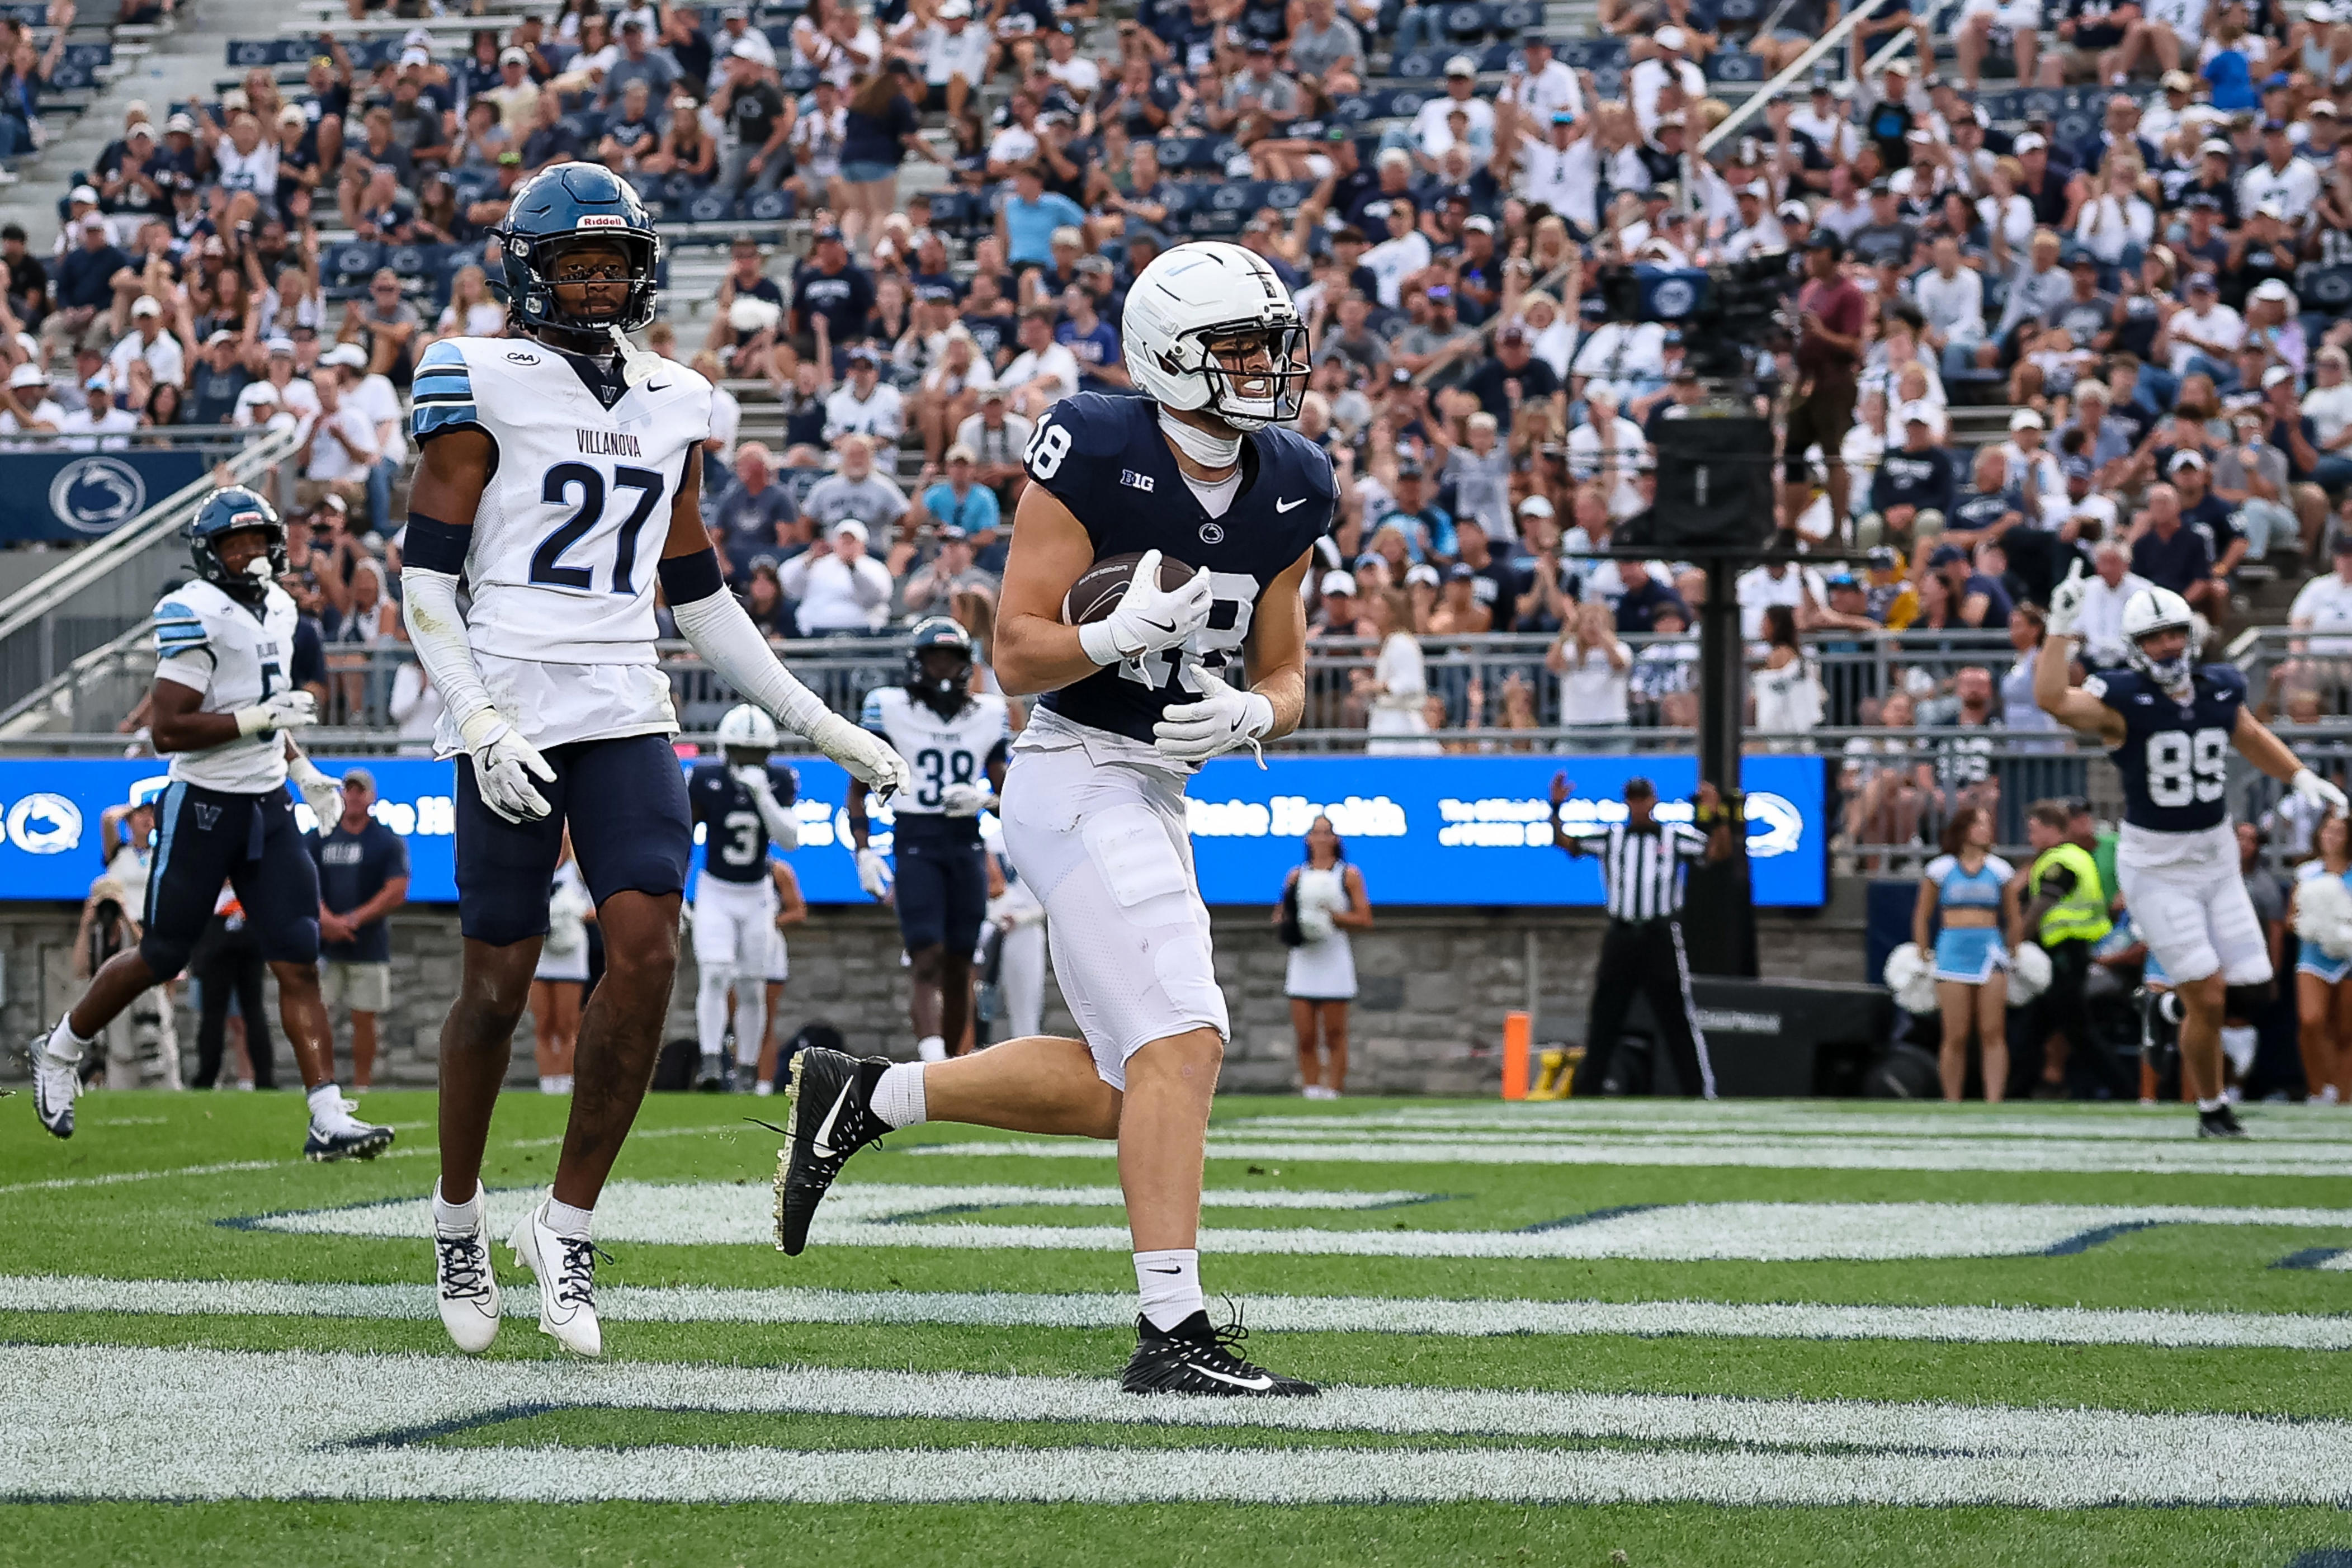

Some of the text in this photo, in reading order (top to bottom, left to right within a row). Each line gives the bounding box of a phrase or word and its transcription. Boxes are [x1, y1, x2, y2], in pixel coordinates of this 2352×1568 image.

[584, 218, 622, 226] Riddell
[506, 352, 535, 363] CAA
[601, 385, 617, 403] V
[576, 429, 642, 458] VILLANOVA
[1023, 413, 1071, 480] 18
[528, 460, 664, 597] 27
[917, 748, 975, 807] 38
[2146, 727, 2230, 807] 89
[193, 801, 223, 831] V
[722, 810, 761, 866] 3
